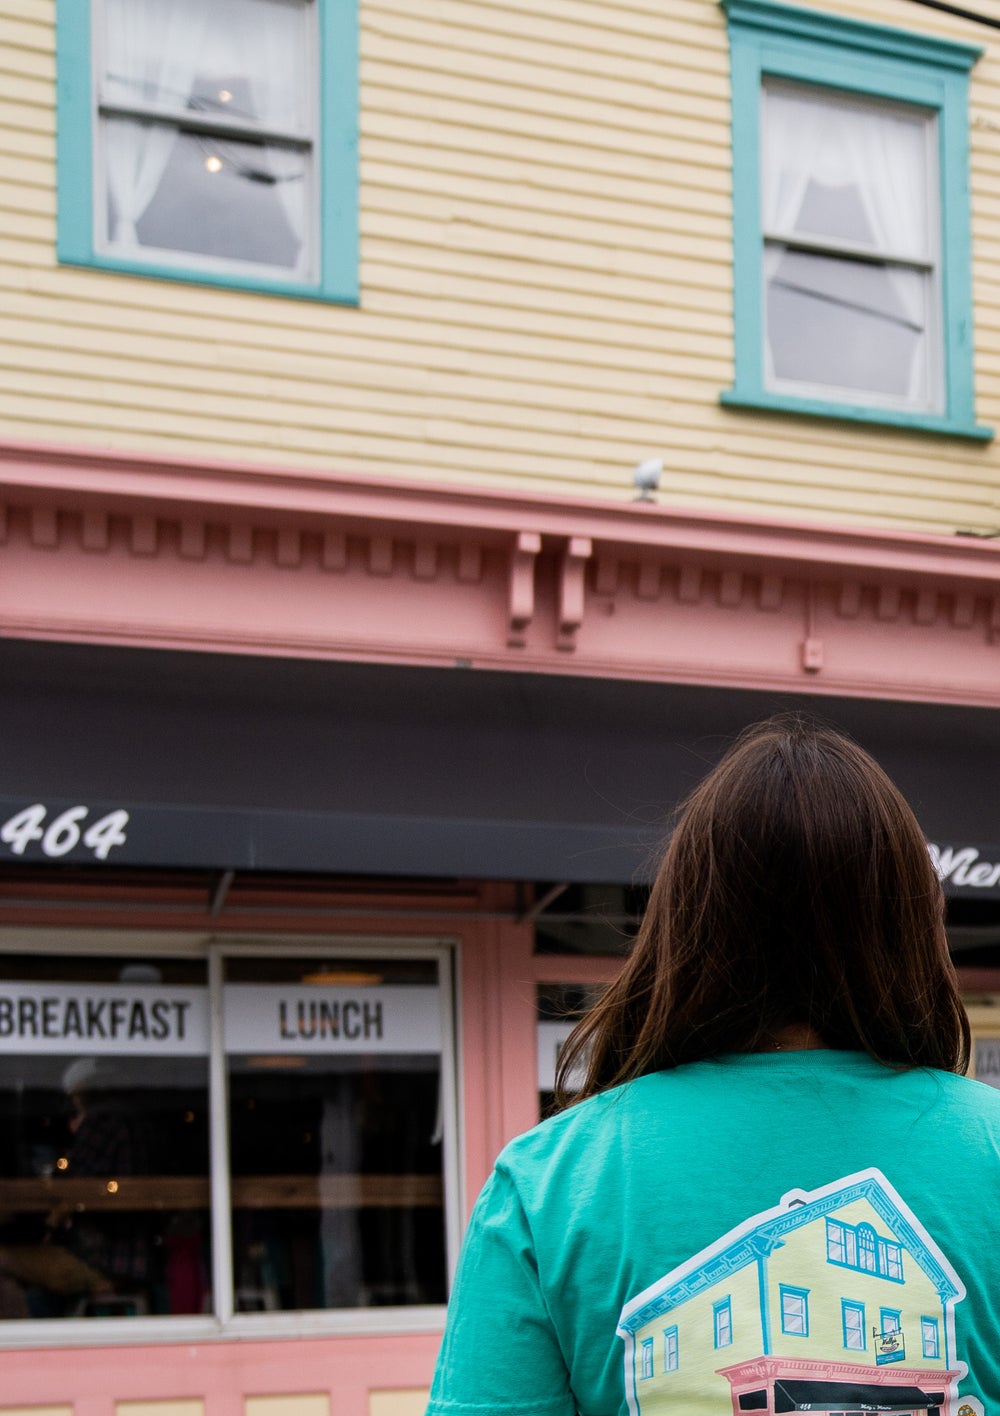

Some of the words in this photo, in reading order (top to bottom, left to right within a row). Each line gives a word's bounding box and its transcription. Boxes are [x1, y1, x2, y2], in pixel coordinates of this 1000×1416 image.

[1, 803, 130, 860] 464
[0, 997, 191, 1041] BREAKFAST
[279, 999, 384, 1039] LUNCH
